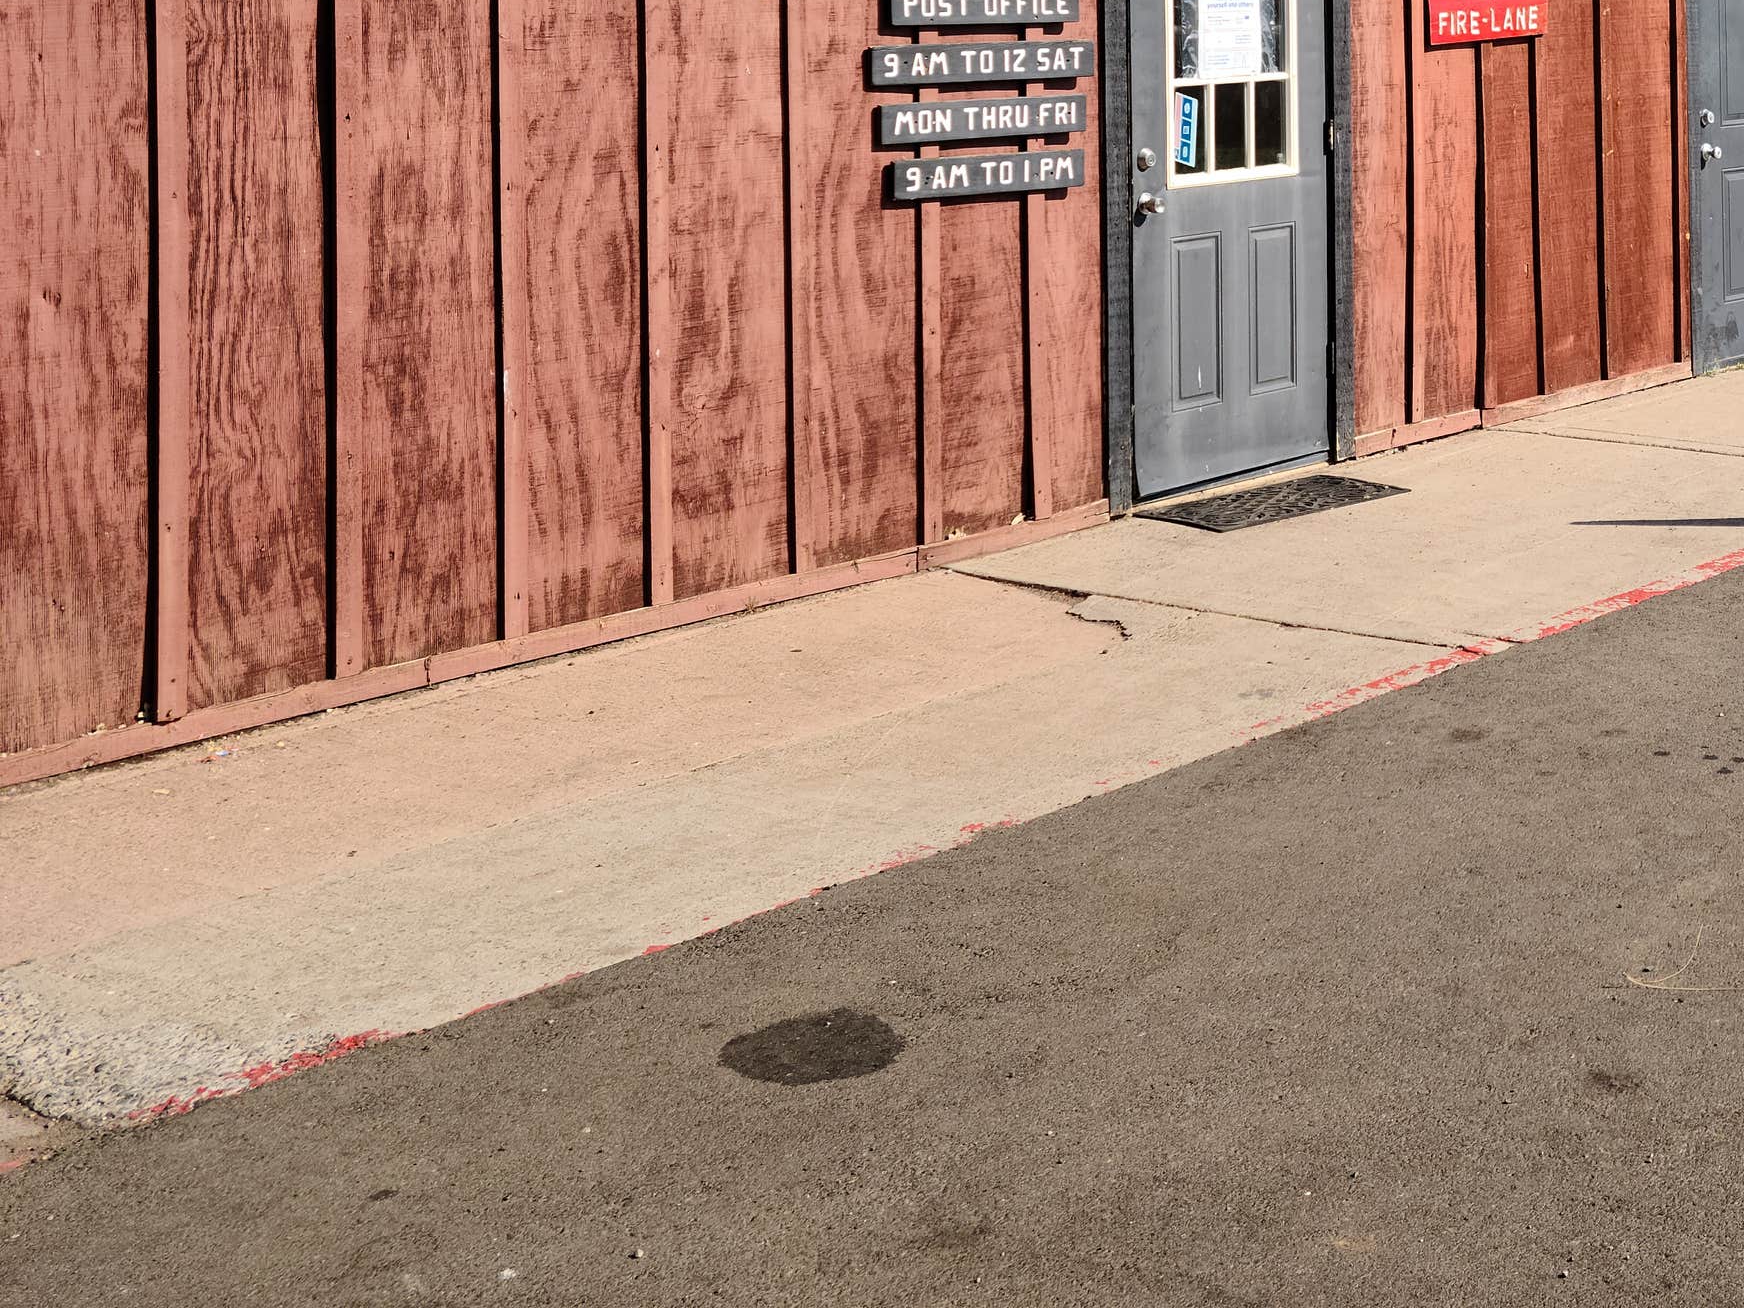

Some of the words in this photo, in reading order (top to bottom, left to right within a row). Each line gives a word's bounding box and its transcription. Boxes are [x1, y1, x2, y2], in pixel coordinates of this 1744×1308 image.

[1438, 5, 1539, 36] FIRE-LANE
[883, 53, 899, 78] 9
[911, 51, 949, 77] AM
[960, 49, 994, 74] TO
[1003, 48, 1026, 73] 12
[1036, 46, 1085, 72] SAT
[893, 108, 952, 136] MON
[963, 103, 1030, 131] THRU
[1038, 101, 1077, 127] FRI
[905, 166, 921, 192] 9
[931, 164, 970, 190] AM
[980, 160, 1014, 186] TO
[1023, 158, 1031, 183] 1
[1038, 156, 1075, 183] PM
